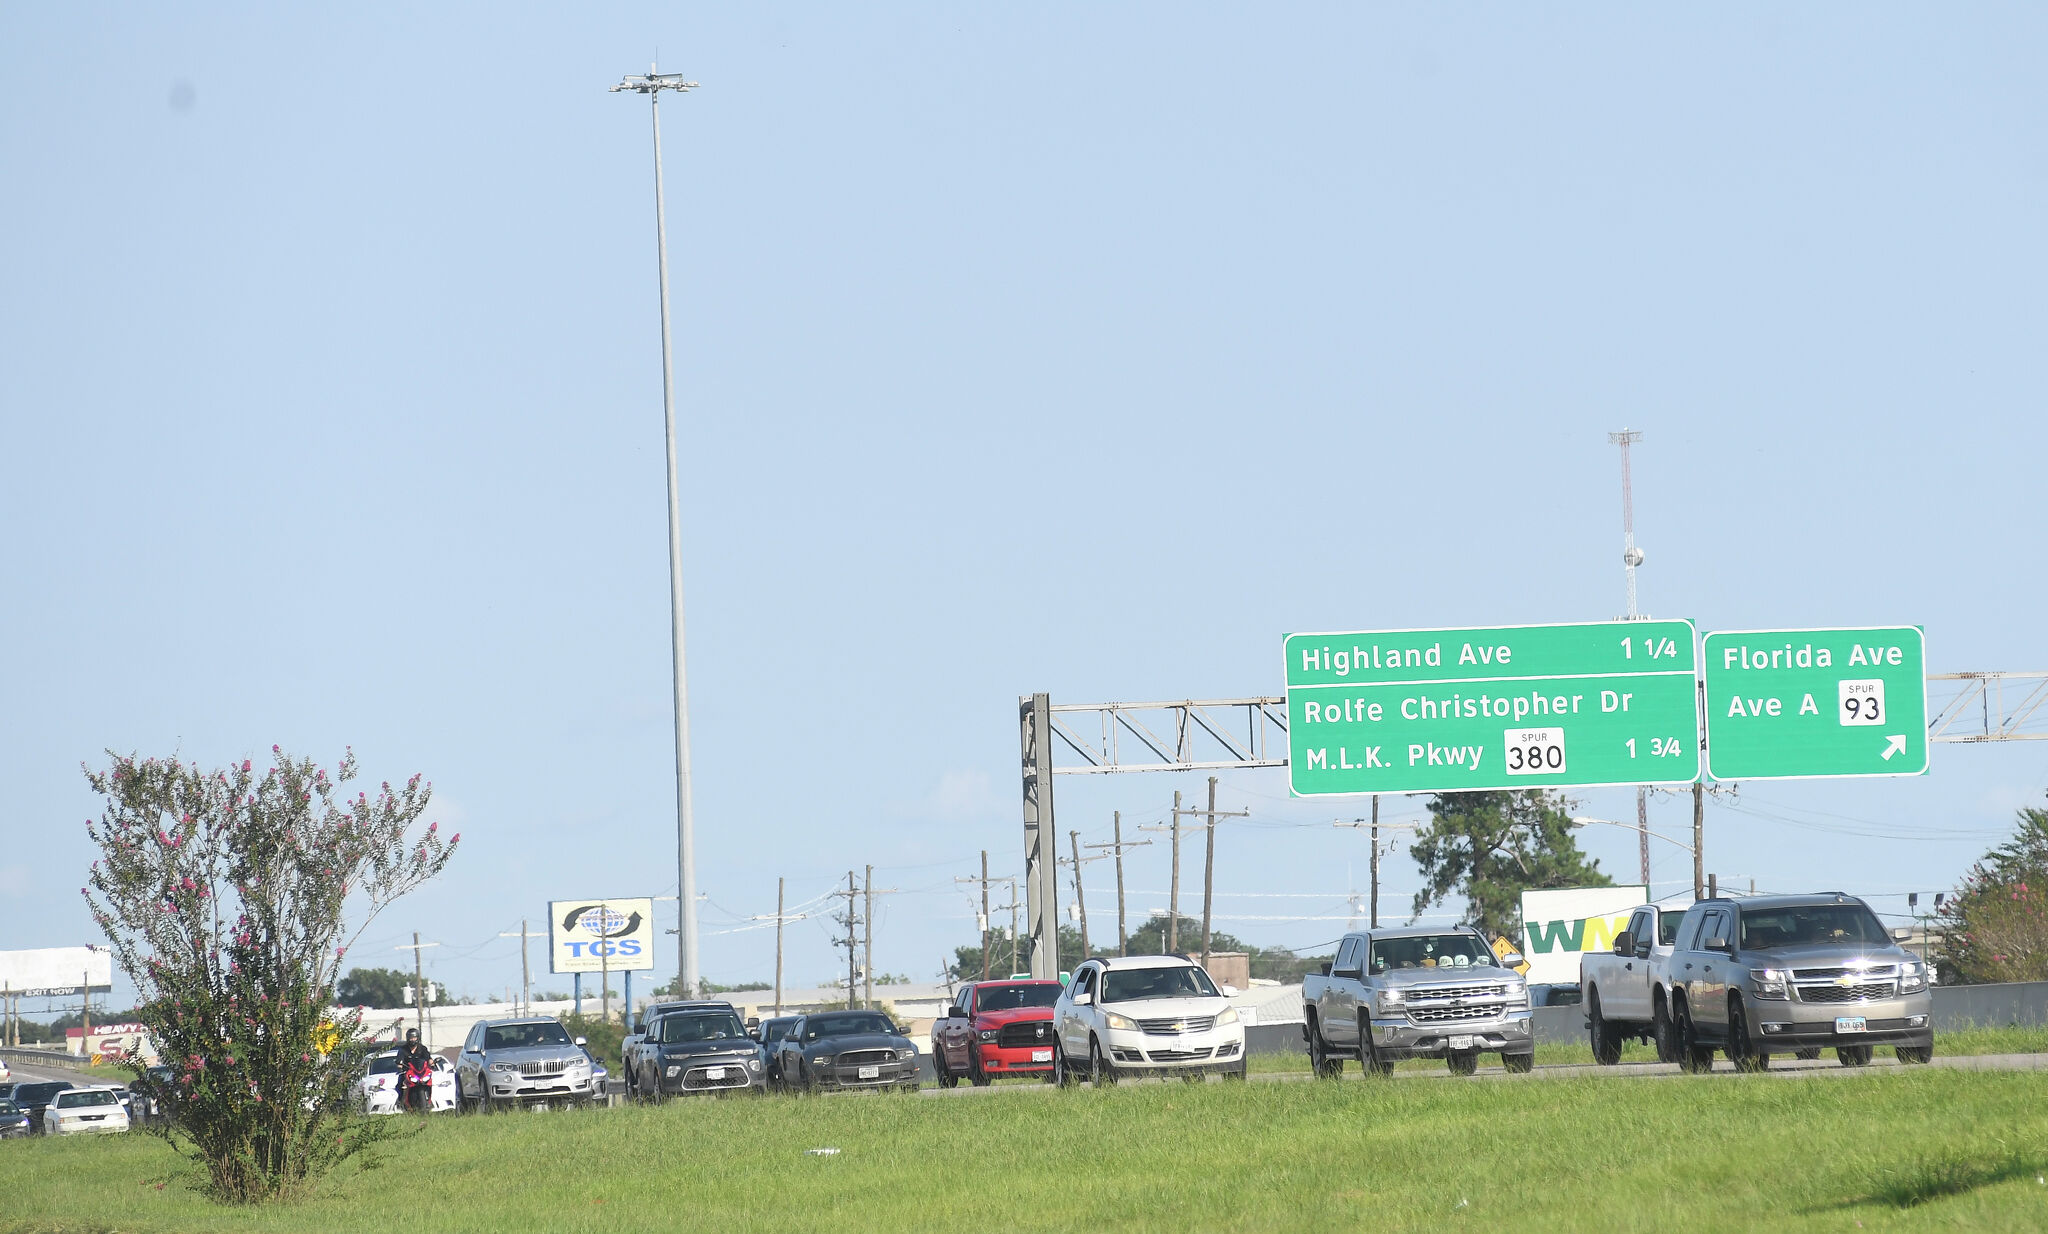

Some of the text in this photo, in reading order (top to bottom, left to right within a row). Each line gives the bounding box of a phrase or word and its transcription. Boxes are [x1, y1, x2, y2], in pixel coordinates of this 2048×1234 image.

[1302, 643, 1441, 676] Highland
[1458, 643, 1512, 665] Ave
[1620, 637, 1632, 659] 1
[1724, 644, 1903, 670] Florida Ave
[1848, 685, 1874, 693] SPUR
[1304, 690, 1633, 724] Rolfe Christopher Dr
[1727, 693, 1819, 718] Ave A
[1845, 697, 1880, 721] 93
[1521, 732, 1547, 743] SPUR
[1306, 736, 1682, 771] M.L.K. Pkwy 1 3/4
[1509, 745, 1562, 770] 380
[563, 939, 642, 958] TGS
[25, 987, 76, 997] EXIT NOW
[93, 1024, 138, 1036] HEAVY
